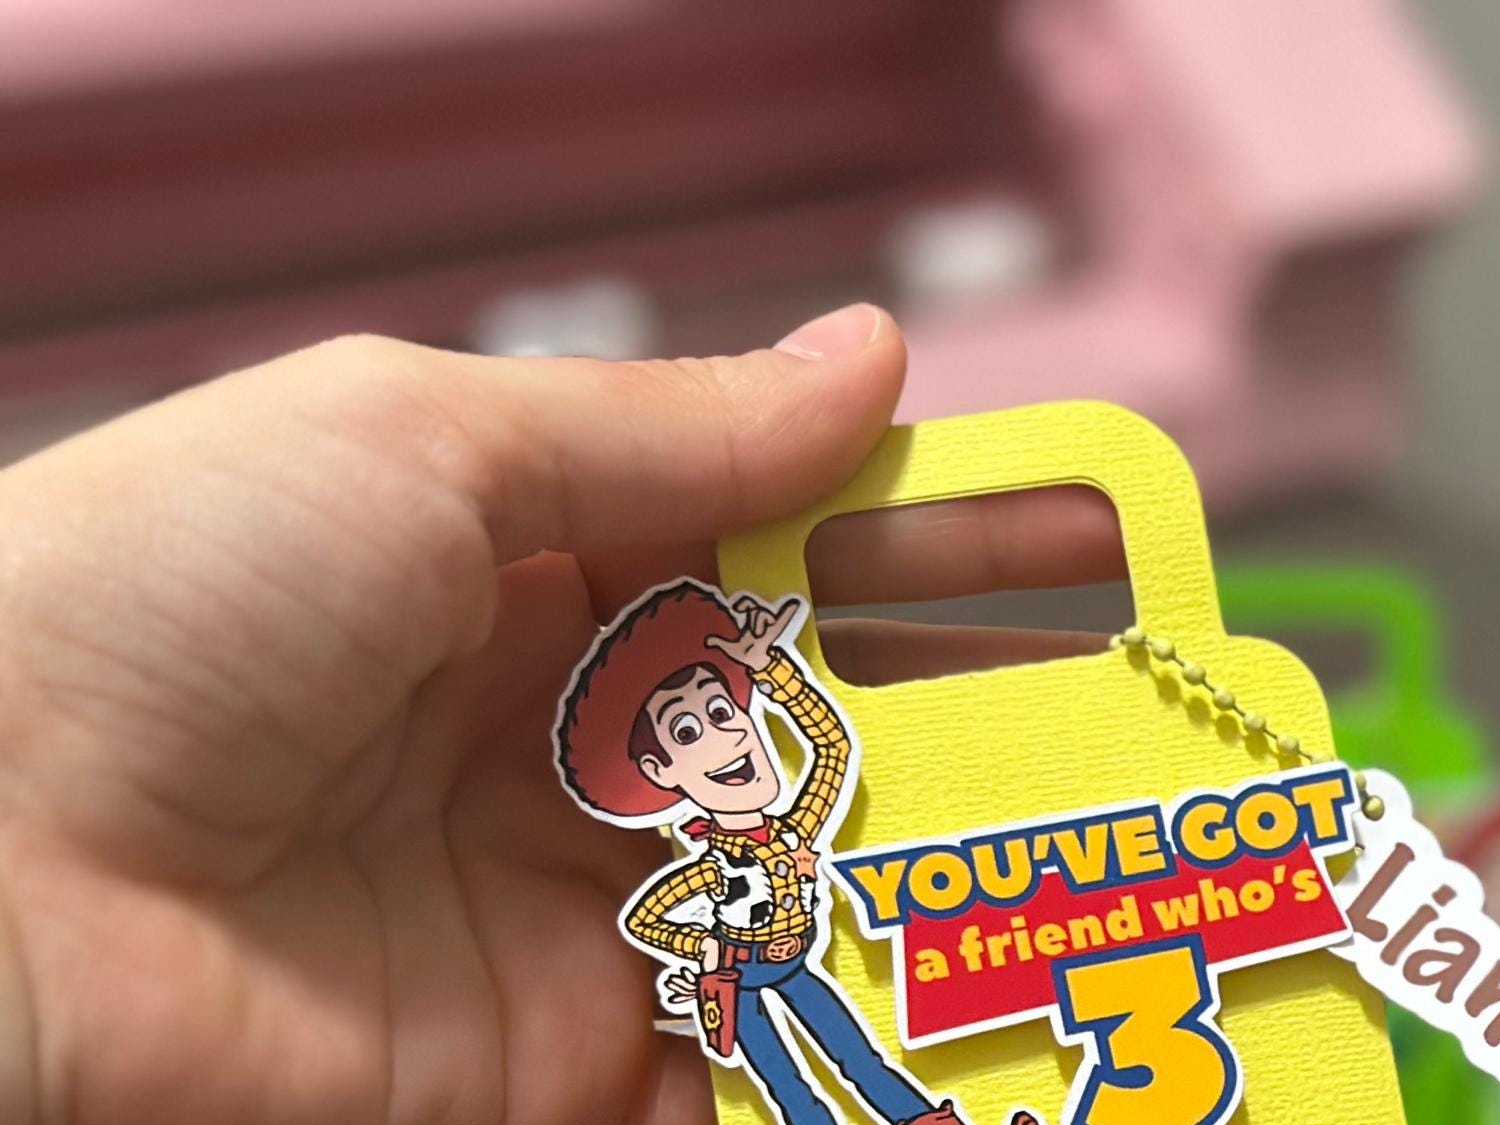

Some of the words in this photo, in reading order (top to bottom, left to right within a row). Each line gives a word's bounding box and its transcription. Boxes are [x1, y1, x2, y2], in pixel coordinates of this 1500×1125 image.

[845, 808, 1172, 926] YOU'VE
[1176, 774, 1349, 866] GOT
[913, 943, 951, 981] a
[958, 897, 1145, 973] friend
[1151, 865, 1323, 933] who's
